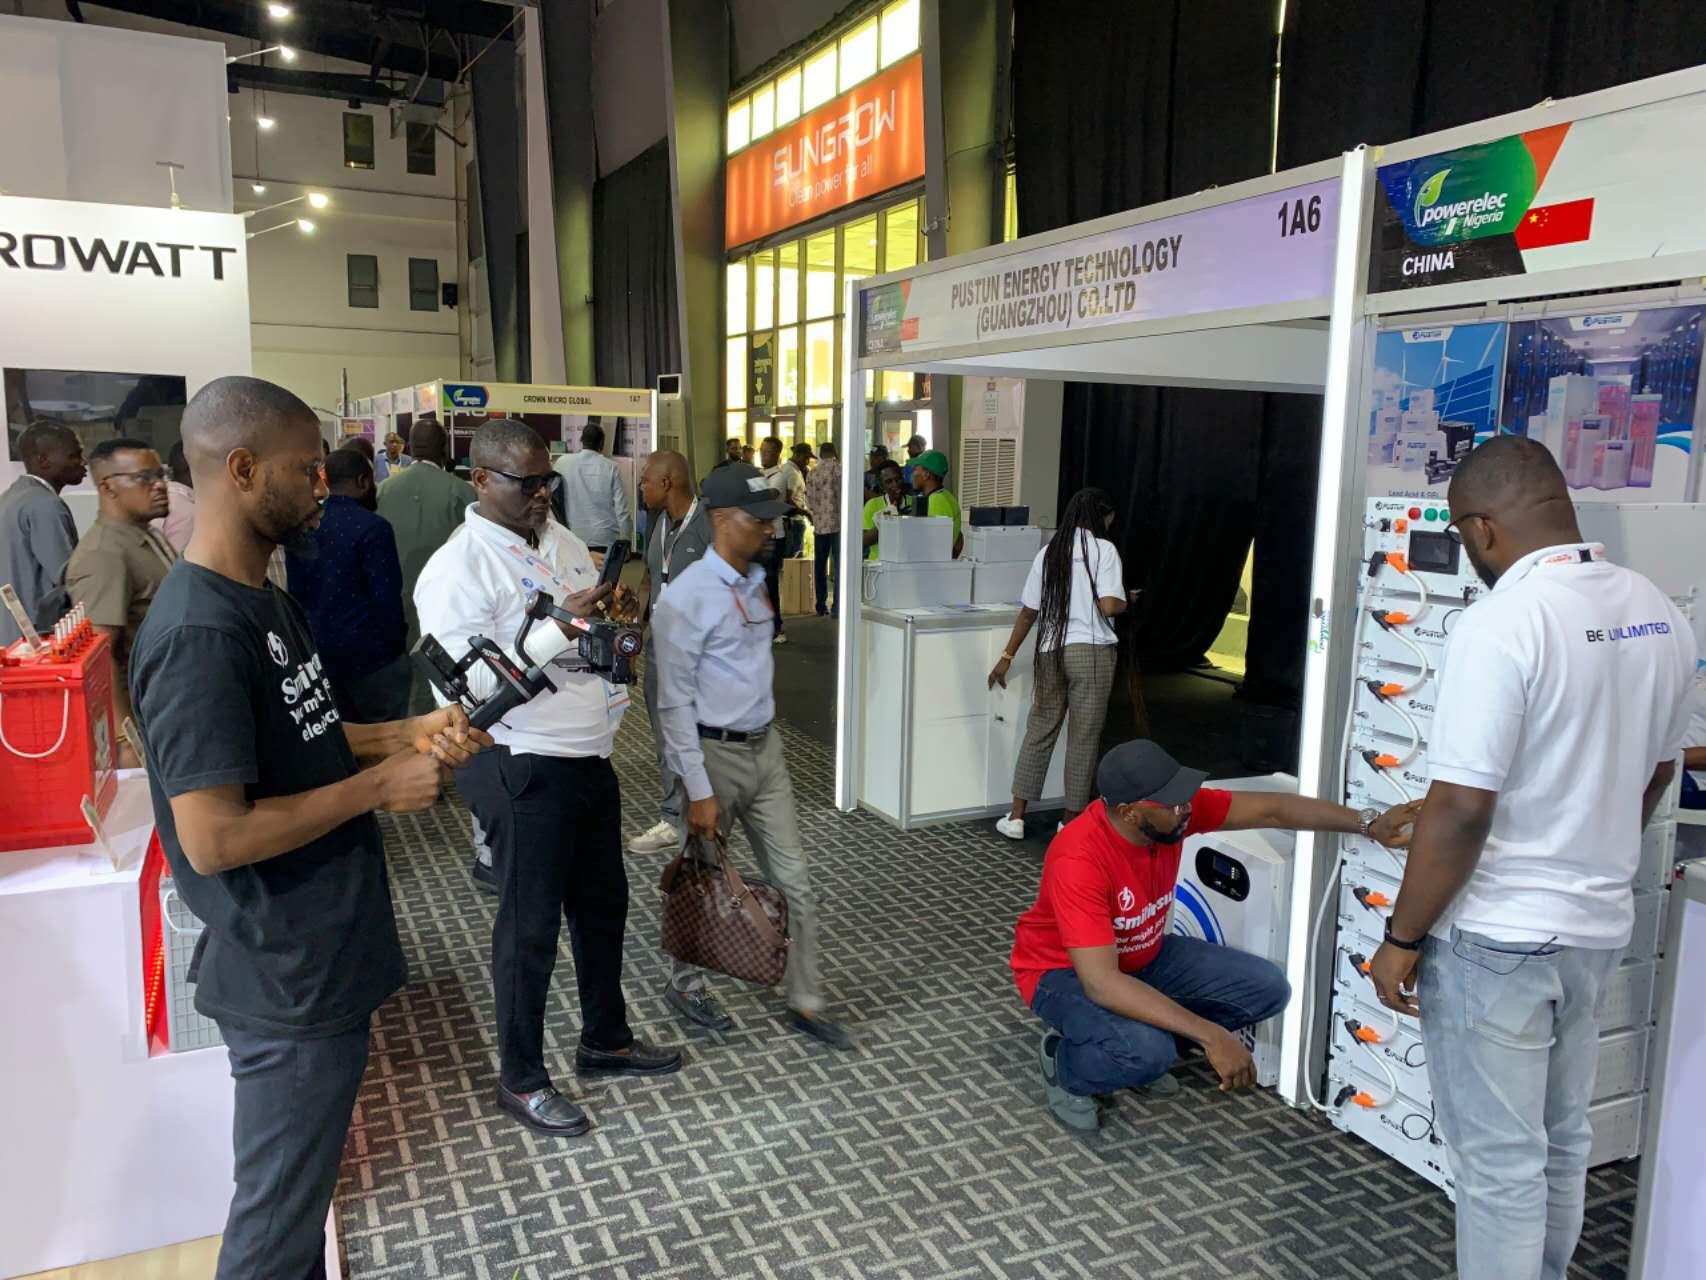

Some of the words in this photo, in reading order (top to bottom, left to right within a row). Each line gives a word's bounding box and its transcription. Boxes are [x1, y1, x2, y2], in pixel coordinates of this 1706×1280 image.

[774, 89, 895, 186] SUNGROW
[1278, 195, 1321, 237] 1A6
[1422, 192, 1508, 227] powerelec
[1463, 210, 1504, 229] Nigeria
[951, 274, 1000, 309] PUSTUN
[1003, 261, 1060, 299] ENERGY
[1065, 234, 1182, 288] TECHNOLOGY
[1402, 251, 1455, 275] CHINA
[976, 291, 1072, 340] (GUANGZHOU)
[1078, 280, 1136, 319] CO.LTD
[523, 395, 546, 404] CROWN
[547, 396, 567, 404] MICRO
[568, 396, 593, 405] GLOBAL
[1585, 629, 1605, 642] BE
[1608, 622, 1671, 641] ULIMITED
